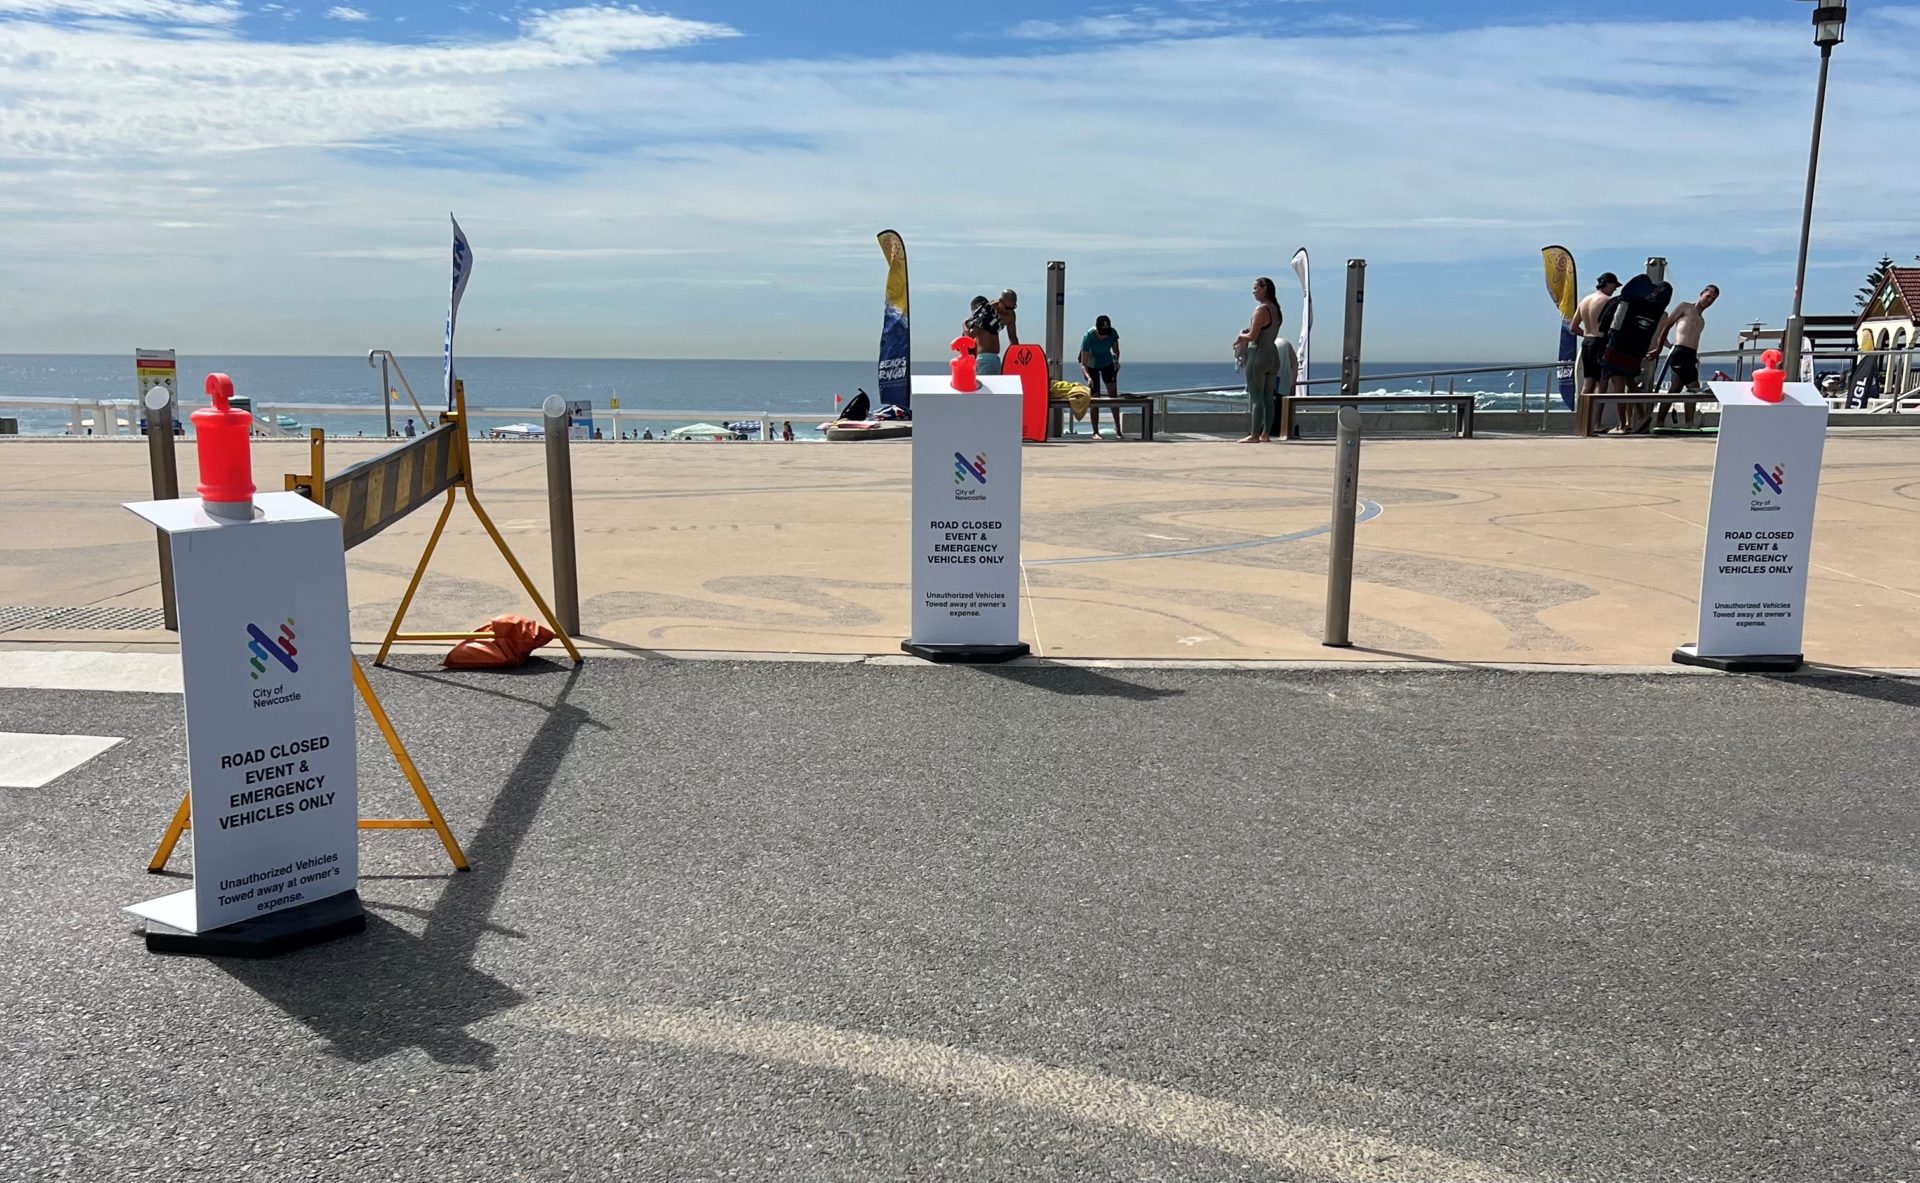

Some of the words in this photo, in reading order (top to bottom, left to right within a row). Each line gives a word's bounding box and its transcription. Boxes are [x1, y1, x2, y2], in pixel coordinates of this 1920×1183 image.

[955, 489, 967, 497] City
[930, 521, 959, 530] ROAD
[961, 521, 1003, 530] CLOSED
[945, 533, 978, 541] EVENT
[980, 533, 987, 541] &
[1724, 531, 1753, 540] ROAD
[1755, 531, 1794, 540] CLOSED
[934, 544, 998, 553] EMERGENCY
[1737, 543, 1770, 551] EVENT
[1772, 543, 1778, 551] &
[927, 555, 976, 564] VEHICLES
[979, 555, 1005, 564] ONLY
[1726, 554, 1788, 563] EMERGENCY
[1718, 565, 1766, 574] VEHICLES
[1768, 565, 1793, 574] ONLY
[949, 610, 982, 618] expense.
[253, 688, 272, 698] City
[274, 684, 284, 695] of
[253, 692, 301, 709] Newcastle
[221, 749, 266, 769] ROAD
[270, 736, 330, 759] CLOSED
[245, 762, 295, 785] EVENT
[299, 760, 309, 773] &
[230, 775, 325, 808] EMERGENCY
[219, 802, 295, 830] VEHICLES
[299, 792, 336, 812] ONLY
[220, 864, 293, 891] Unauthorized
[295, 853, 338, 871] Vehicles
[218, 889, 254, 906] Towed
[257, 883, 285, 897] away
[287, 878, 297, 889] at
[300, 866, 340, 885] owner's
[257, 892, 305, 911] expense.
